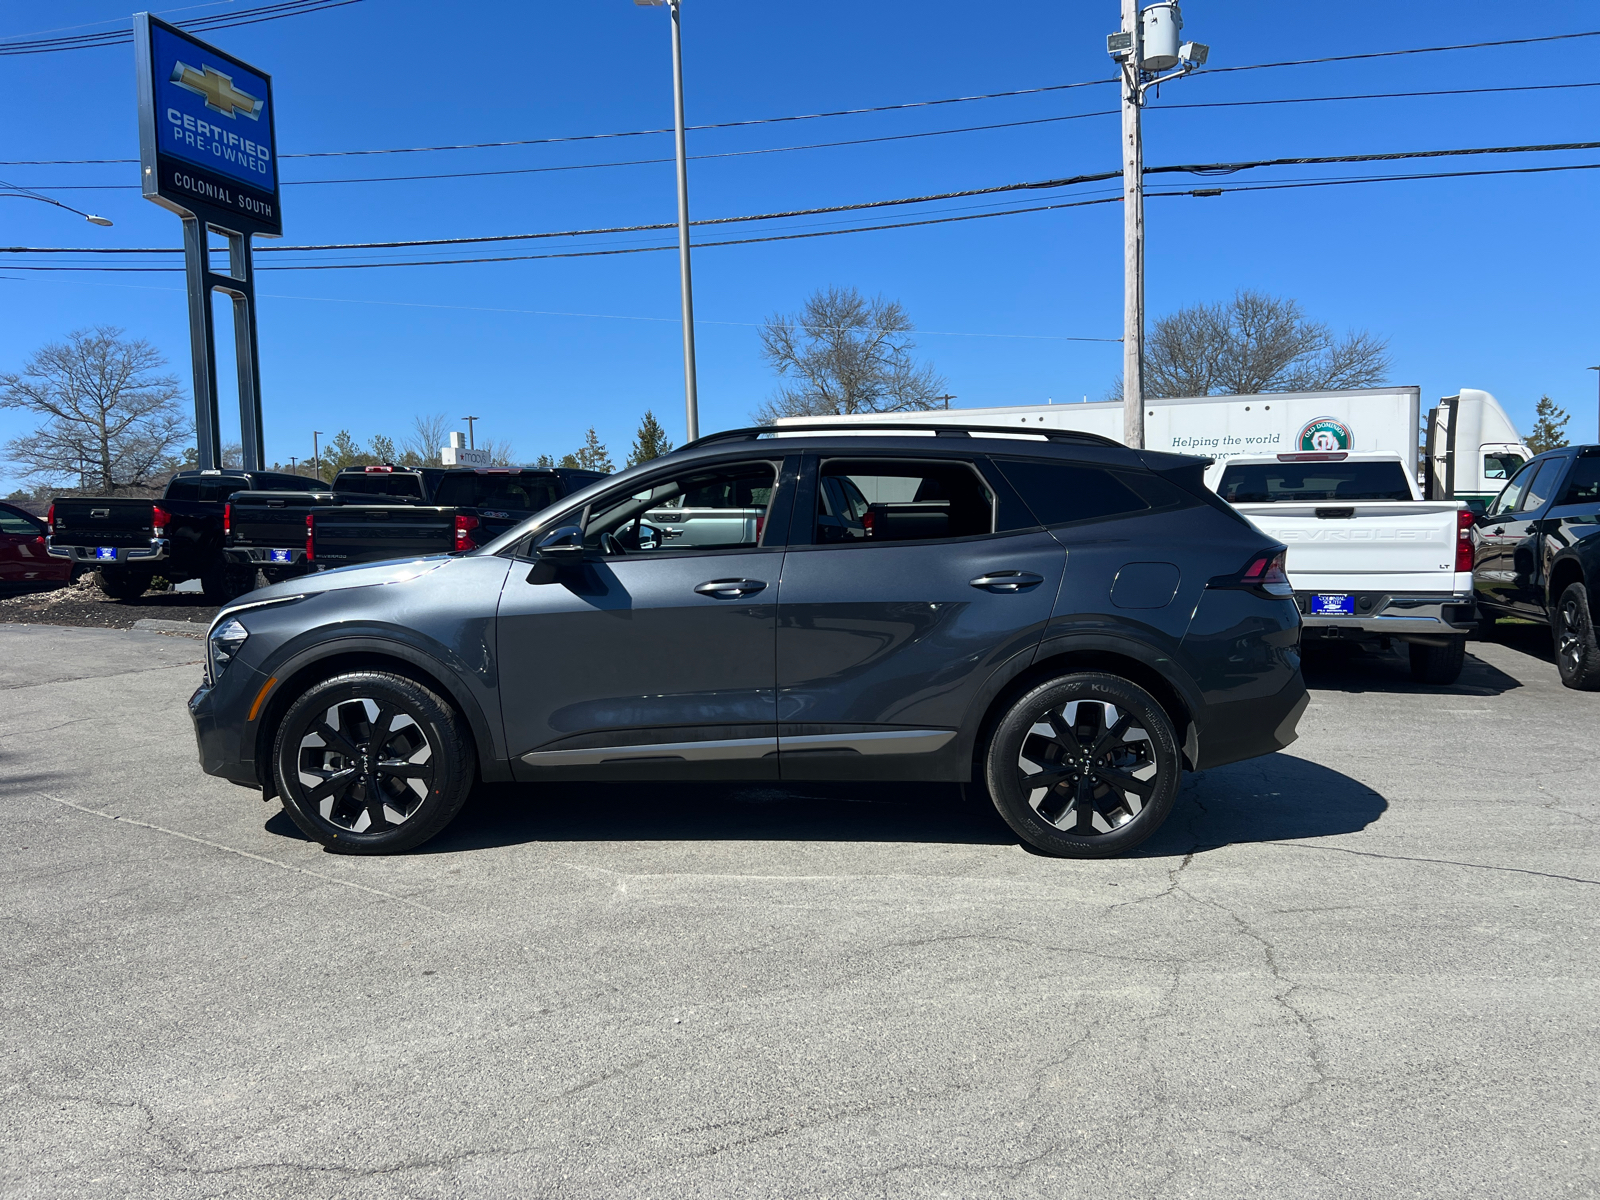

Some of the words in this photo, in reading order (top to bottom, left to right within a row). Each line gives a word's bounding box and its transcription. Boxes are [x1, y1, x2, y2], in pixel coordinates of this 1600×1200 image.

[167, 108, 270, 161] CERTIFIED
[174, 127, 267, 174] PRE-OWNED
[174, 172, 232, 204] COLONIAL
[238, 194, 272, 217] SOUTH
[1172, 436, 1220, 449] Helping
[1223, 435, 1242, 445] the
[1246, 433, 1280, 445] world
[1304, 427, 1316, 438] OLD
[1316, 422, 1346, 437] DOMINION
